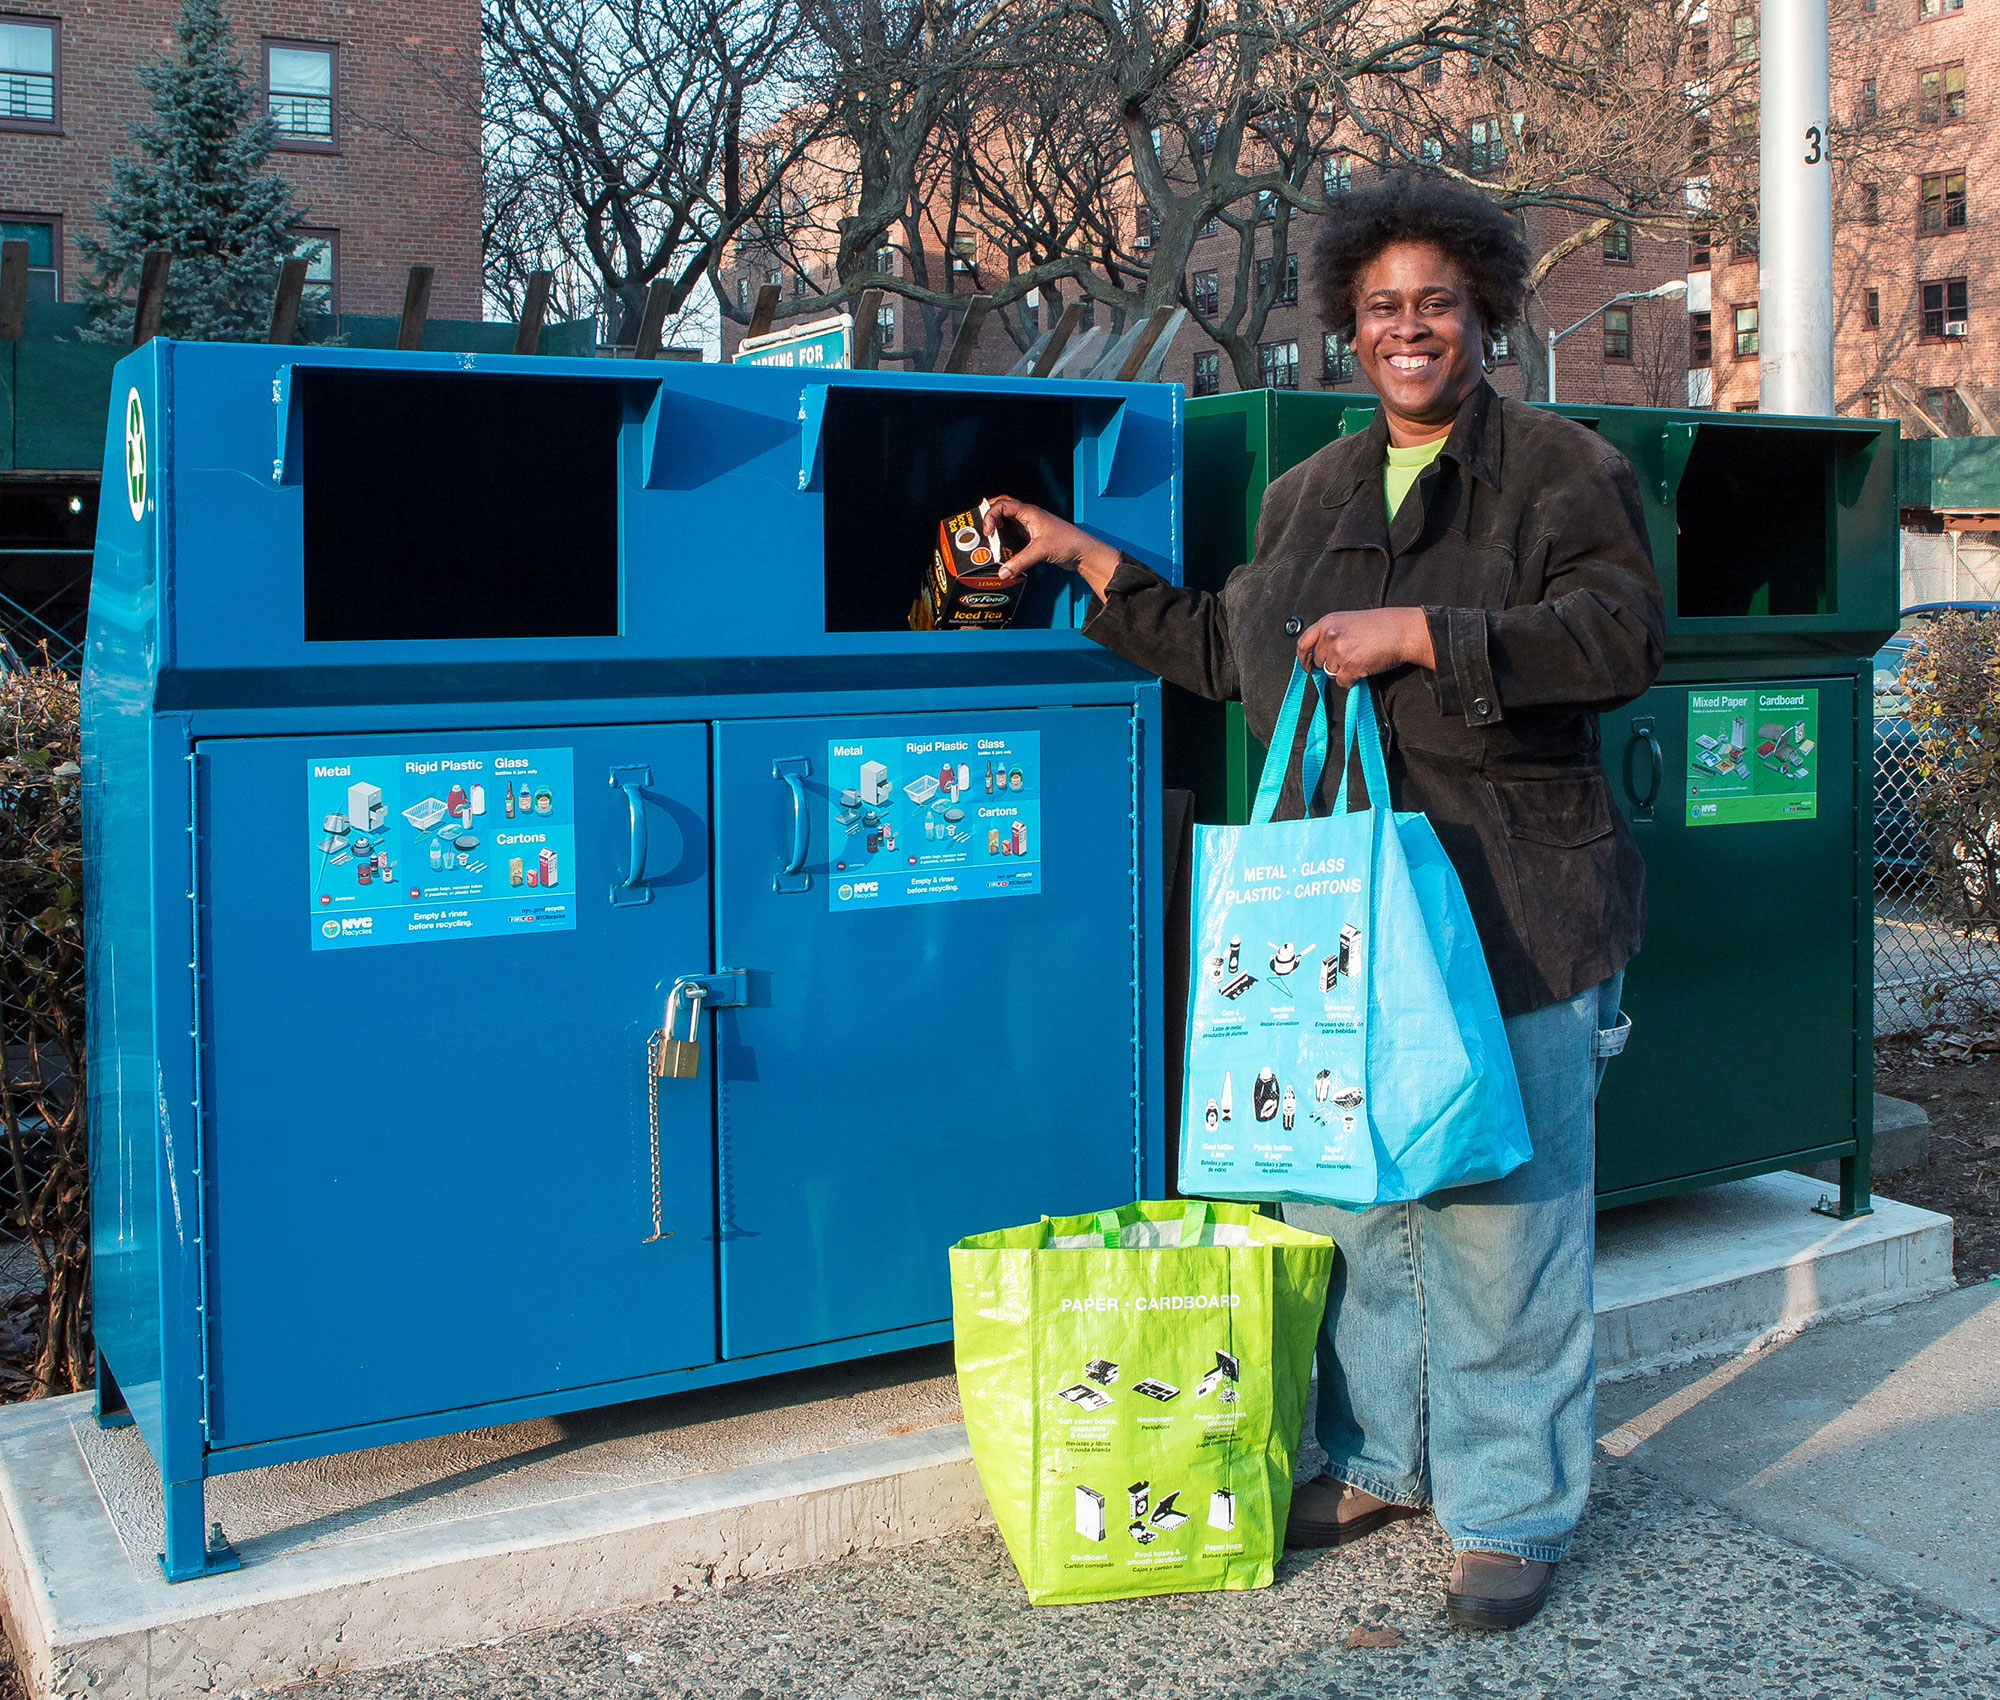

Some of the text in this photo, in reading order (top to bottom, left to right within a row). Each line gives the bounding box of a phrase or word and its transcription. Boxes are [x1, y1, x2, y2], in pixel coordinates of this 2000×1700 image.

[799, 345, 823, 366] FOR
[954, 611, 982, 619] Iced
[1693, 696, 1748, 708] Mixed Paper
[1760, 694, 1804, 706] Cardboard
[906, 741, 968, 754] Rigid Plastic
[978, 739, 1005, 749] Glass
[834, 746, 863, 757] Metal
[405, 759, 483, 773] Rigid Plastic
[495, 757, 529, 769] Glass
[314, 765, 350, 778] Metal
[978, 806, 1017, 817] Cartons
[496, 832, 546, 845] Cartons
[1244, 858, 1345, 882] METAL GLASS
[854, 881, 878, 892] NYC
[929, 884, 959, 893] recycling.
[1225, 878, 1362, 905] PLASTIC CARTONS
[414, 912, 439, 921] Empty
[342, 917, 373, 929] NYC
[409, 919, 473, 931] before recycling.
[342, 928, 372, 936] Recycles
[1061, 1294, 1240, 1312] PAPER CARDBOARD
